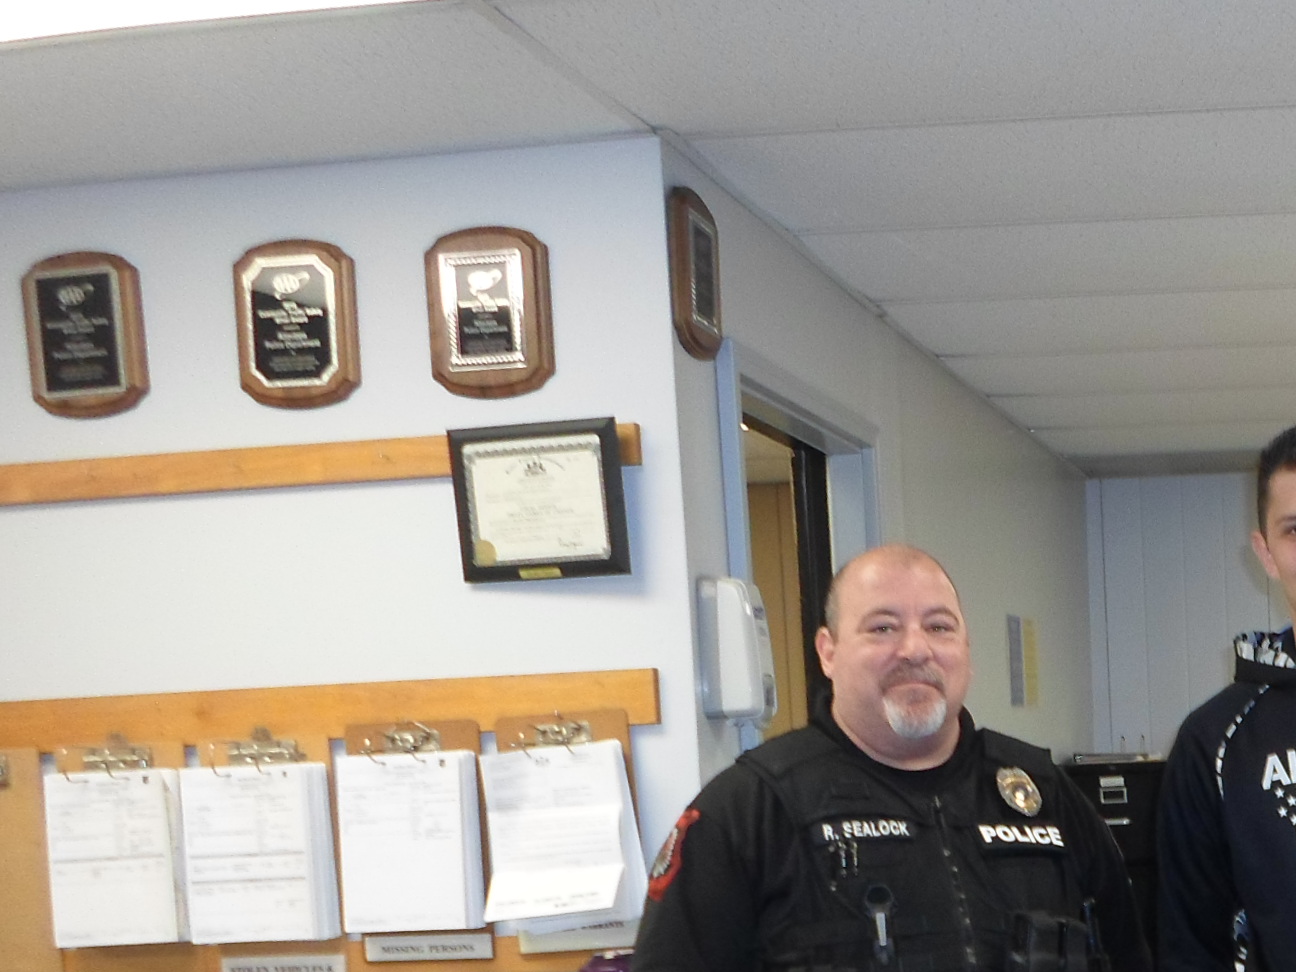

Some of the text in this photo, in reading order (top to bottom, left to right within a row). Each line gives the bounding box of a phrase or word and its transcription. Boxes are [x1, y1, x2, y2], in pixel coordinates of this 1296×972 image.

[822, 819, 910, 841] R. SEALOCK
[978, 824, 1065, 847] POLICE
[381, 944, 476, 954] MISSING PERSONS
